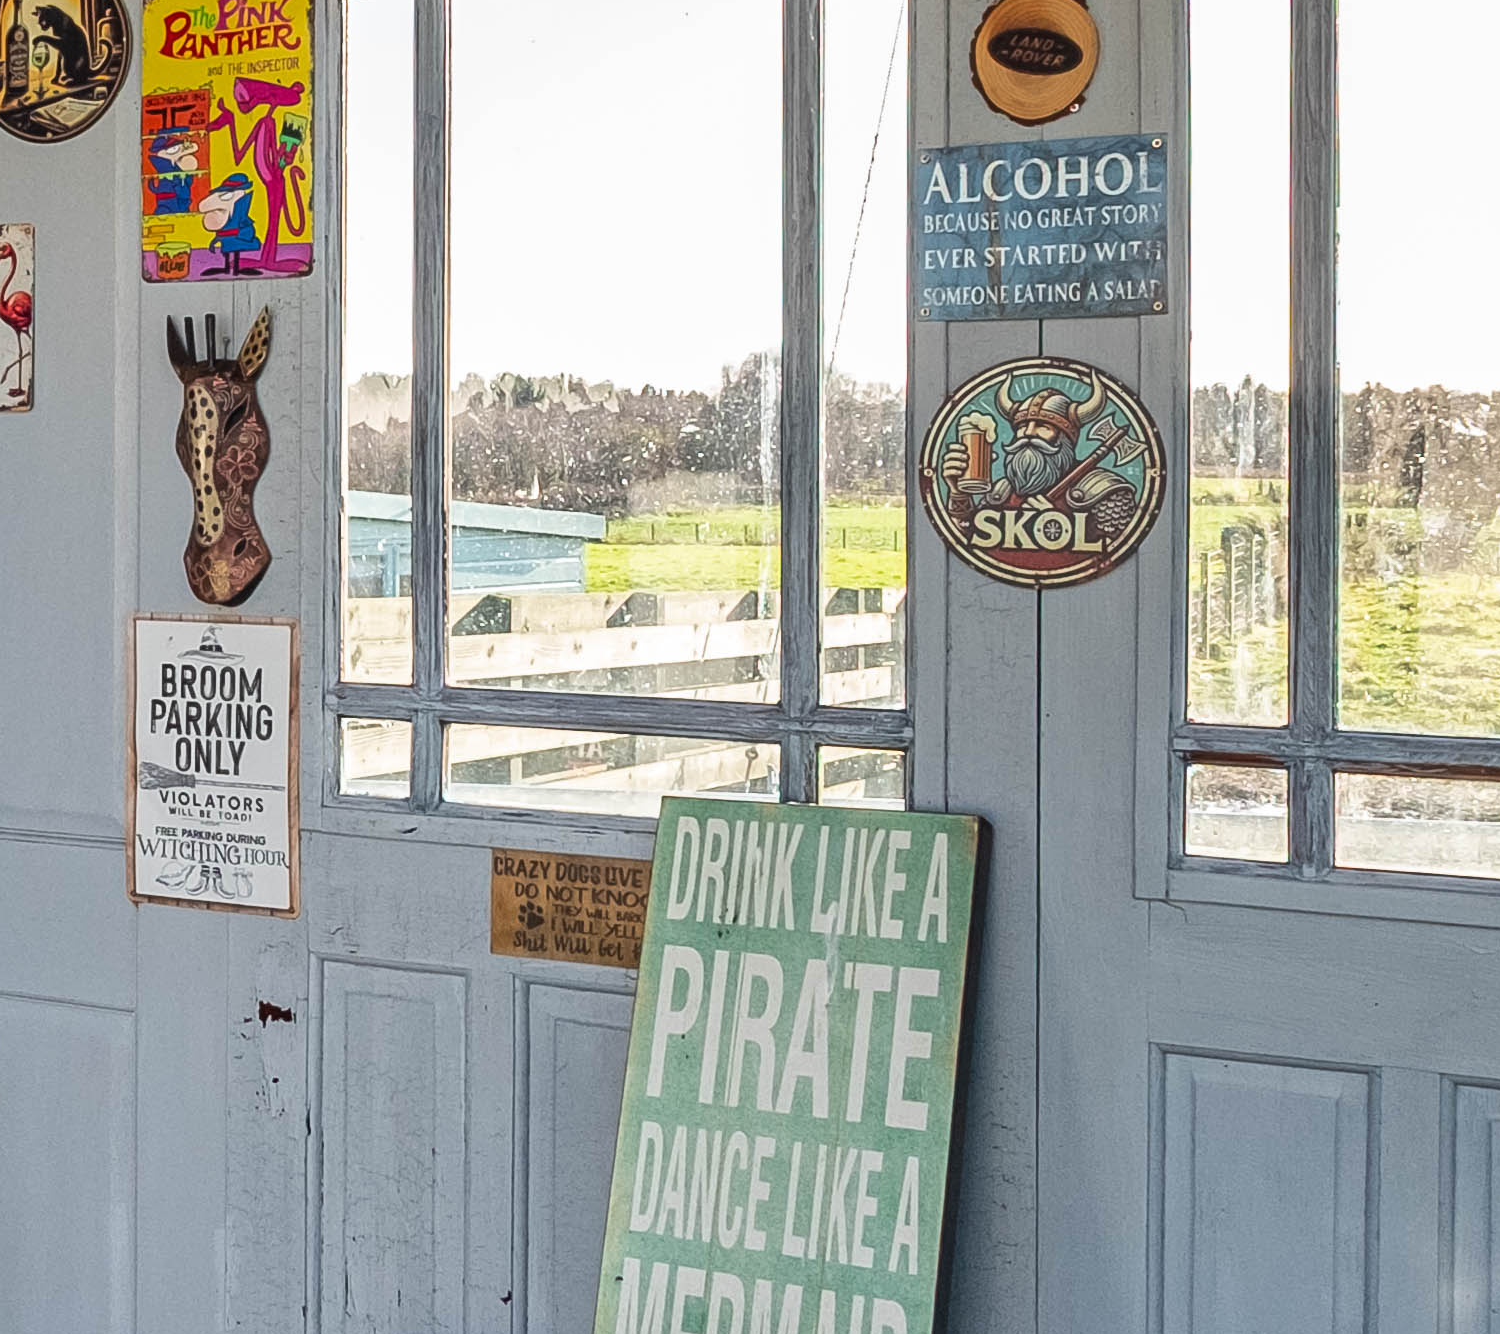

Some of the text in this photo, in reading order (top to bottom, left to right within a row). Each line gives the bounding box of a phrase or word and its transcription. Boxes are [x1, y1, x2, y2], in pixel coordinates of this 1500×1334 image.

[159, 11, 300, 60] PANTHER
[186, 6, 216, 29] The
[1009, 35, 1055, 51] LAND
[1010, 48, 1064, 66] ROVER
[924, 152, 1162, 205] ALCOHOL
[924, 203, 1162, 233] BECAUSE NO GREAT STORY
[924, 241, 1161, 269] EVER STARTED WITH
[971, 510, 1102, 552] SKOL
[161, 663, 262, 703] BROOM
[150, 699, 273, 740] PARKING
[175, 737, 245, 776] ONLY
[159, 790, 264, 812] VIOLATORS
[136, 834, 290, 869] WITCHING HOUR
[494, 856, 643, 888] CRAZY DOGS LIVE
[666, 816, 948, 943] DRINK LIKE A
[646, 945, 940, 1131] PIRATE
[630, 1120, 919, 1275] DANCE LIKE A
